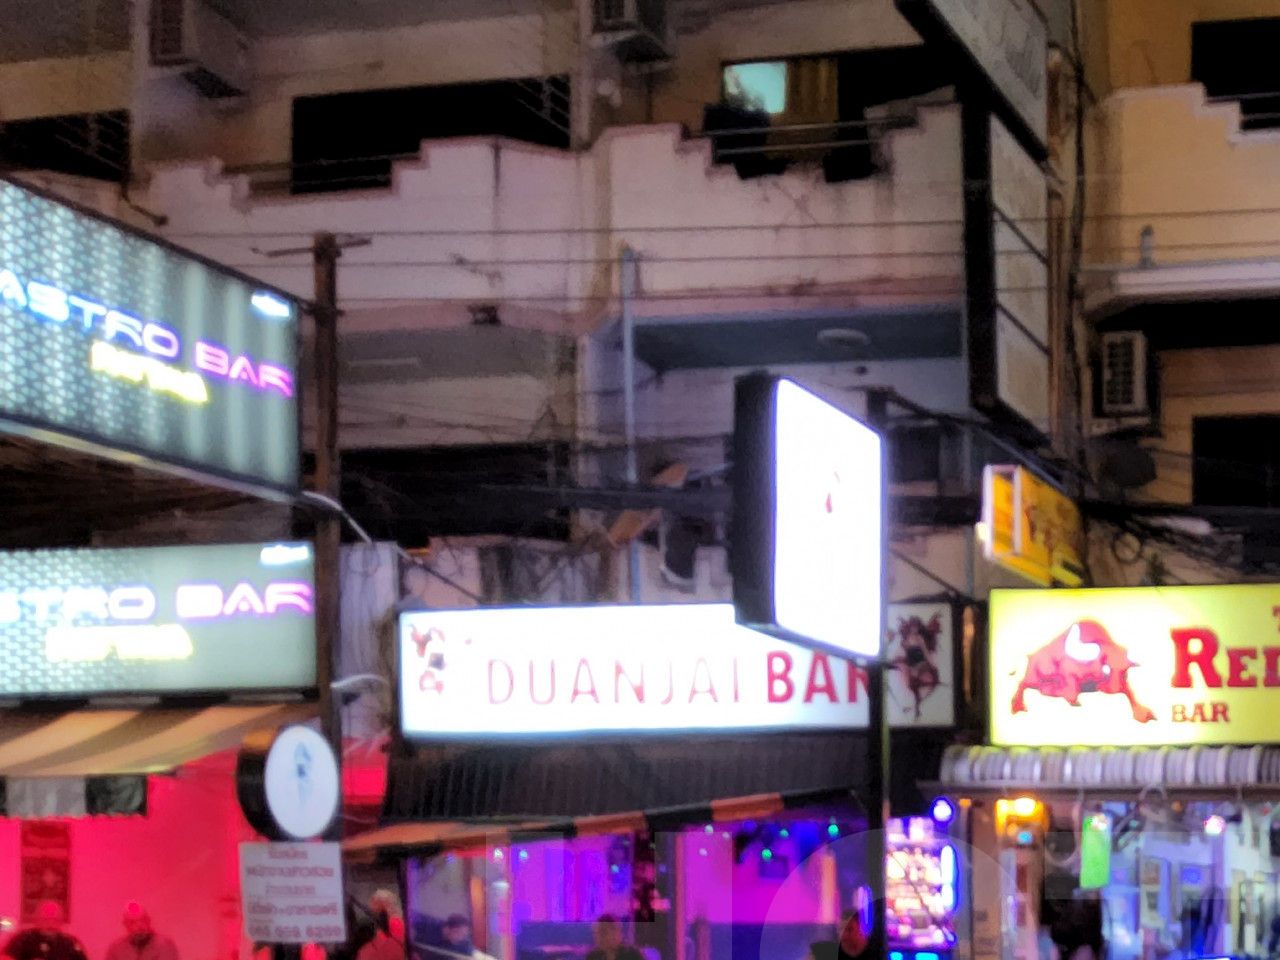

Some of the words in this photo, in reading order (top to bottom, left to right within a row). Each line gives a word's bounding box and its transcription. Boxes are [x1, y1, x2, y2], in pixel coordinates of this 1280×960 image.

[195, 341, 294, 398] BAR
[175, 582, 314, 619] BAR
[487, 656, 742, 705] DUANJAI
[1171, 701, 1231, 723] BAR
